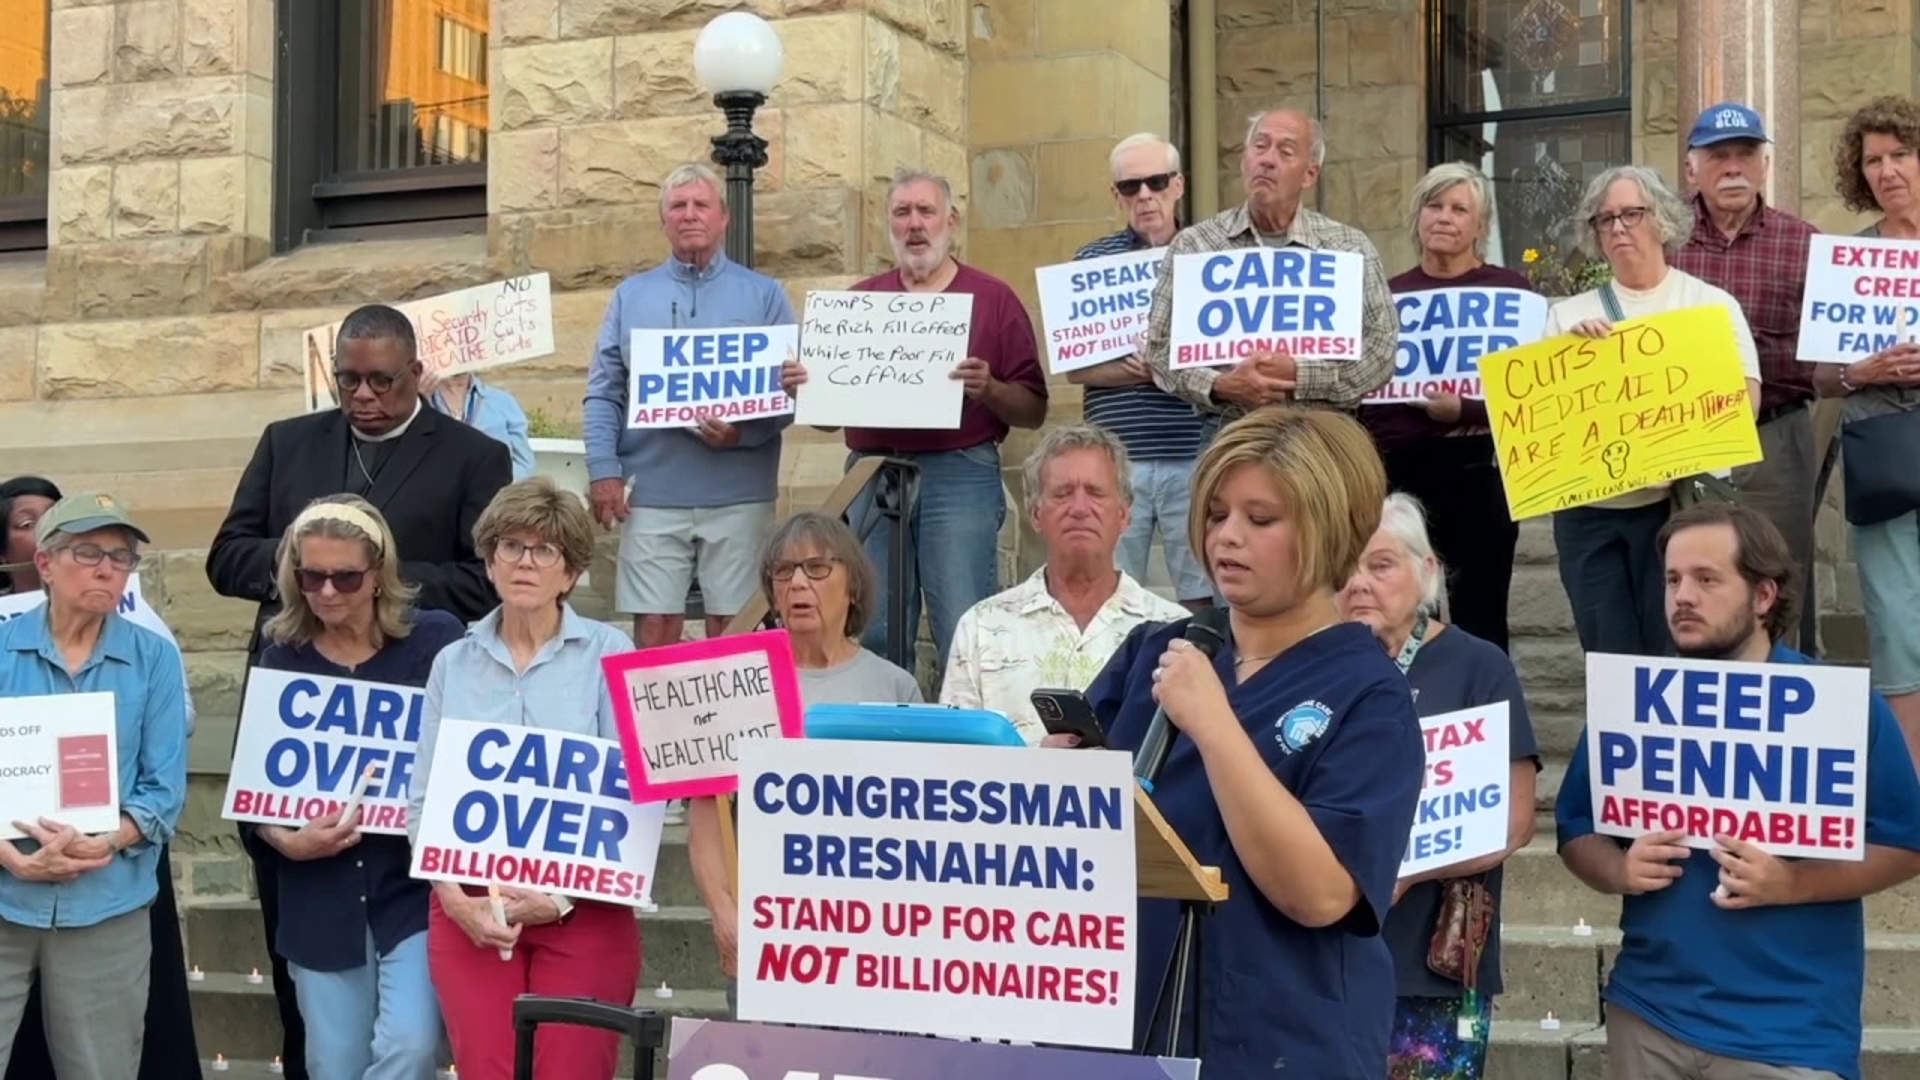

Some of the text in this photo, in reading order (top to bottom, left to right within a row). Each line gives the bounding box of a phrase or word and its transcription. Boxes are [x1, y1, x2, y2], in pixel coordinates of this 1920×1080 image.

[1716, 117, 1749, 128] BLUE
[502, 277, 532, 293] NO
[1201, 251, 1335, 292] CARE
[1854, 276, 1920, 297] CRED
[432, 300, 488, 333] Security
[804, 318, 832, 334] The
[836, 319, 873, 336] Rich
[882, 319, 907, 334] Fill
[1053, 321, 1105, 342] STAND
[1110, 315, 1132, 330] UP
[1197, 294, 1337, 337] OVER
[1395, 292, 1521, 333] CARE
[1811, 301, 1866, 324] FOR
[663, 332, 769, 367] KEEP
[857, 345, 885, 361] The
[890, 345, 925, 361] Poor
[928, 347, 955, 363] Fill
[1058, 340, 1098, 360] NOT
[1177, 336, 1355, 364] BILLIONAIRES!
[1505, 324, 1664, 400] CUTS TO
[1838, 332, 1916, 354] FAM
[634, 395, 789, 423] AFFORDABLE!
[1499, 365, 1689, 445] MEDICAID
[1505, 432, 1566, 477] ARE
[1582, 421, 1599, 448] A
[1619, 402, 1695, 436] DEATH
[632, 666, 771, 712] HEALTHCARE
[1634, 666, 1815, 733] KEEP
[18, 725, 42, 736] OFF
[694, 711, 717, 726] not
[1423, 718, 1486, 753] TAX
[467, 728, 631, 801] CARE
[1599, 731, 1855, 808] PENNIE
[753, 772, 1122, 830] CONGRESSMAN
[453, 790, 629, 862] OVER
[1600, 795, 1855, 850] AFFORDABLE!
[420, 846, 645, 900] BILLIONAIRES!
[783, 834, 1095, 892] BRESNAHAN:
[753, 895, 1125, 950] STAND UP FOR CARE
[757, 943, 1119, 1006] NOT BILLIONAIRES!
